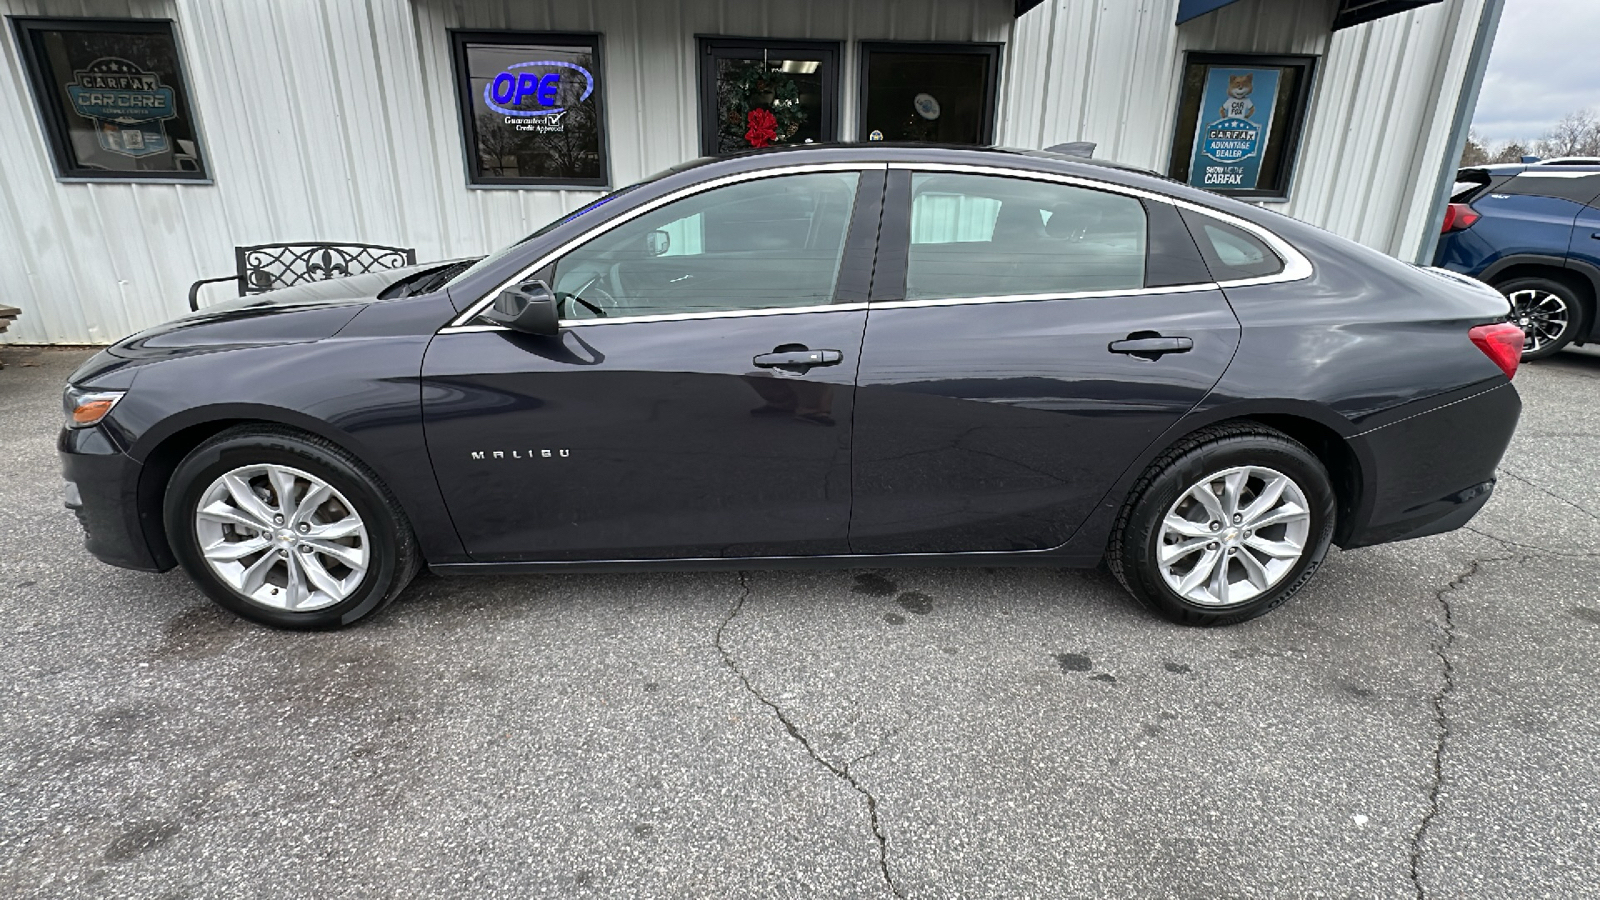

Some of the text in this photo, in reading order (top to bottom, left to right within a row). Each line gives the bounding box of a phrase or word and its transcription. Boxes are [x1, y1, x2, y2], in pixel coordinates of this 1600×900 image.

[82, 77, 156, 91] CARFAX
[78, 92, 166, 108] CAR CARE
[1231, 101, 1245, 109] CAR
[504, 116, 547, 124] Guaranteed
[536, 124, 564, 134] Approval
[1210, 131, 1256, 140] CARFAX
[1210, 141, 1251, 150] ADVANTAGE
[1215, 149, 1243, 158] DEALER
[1206, 166, 1224, 174] SHOW
[1204, 173, 1244, 184] CARFAX
[471, 449, 570, 460] MALIBU
[1267, 561, 1319, 609] KUMHO
